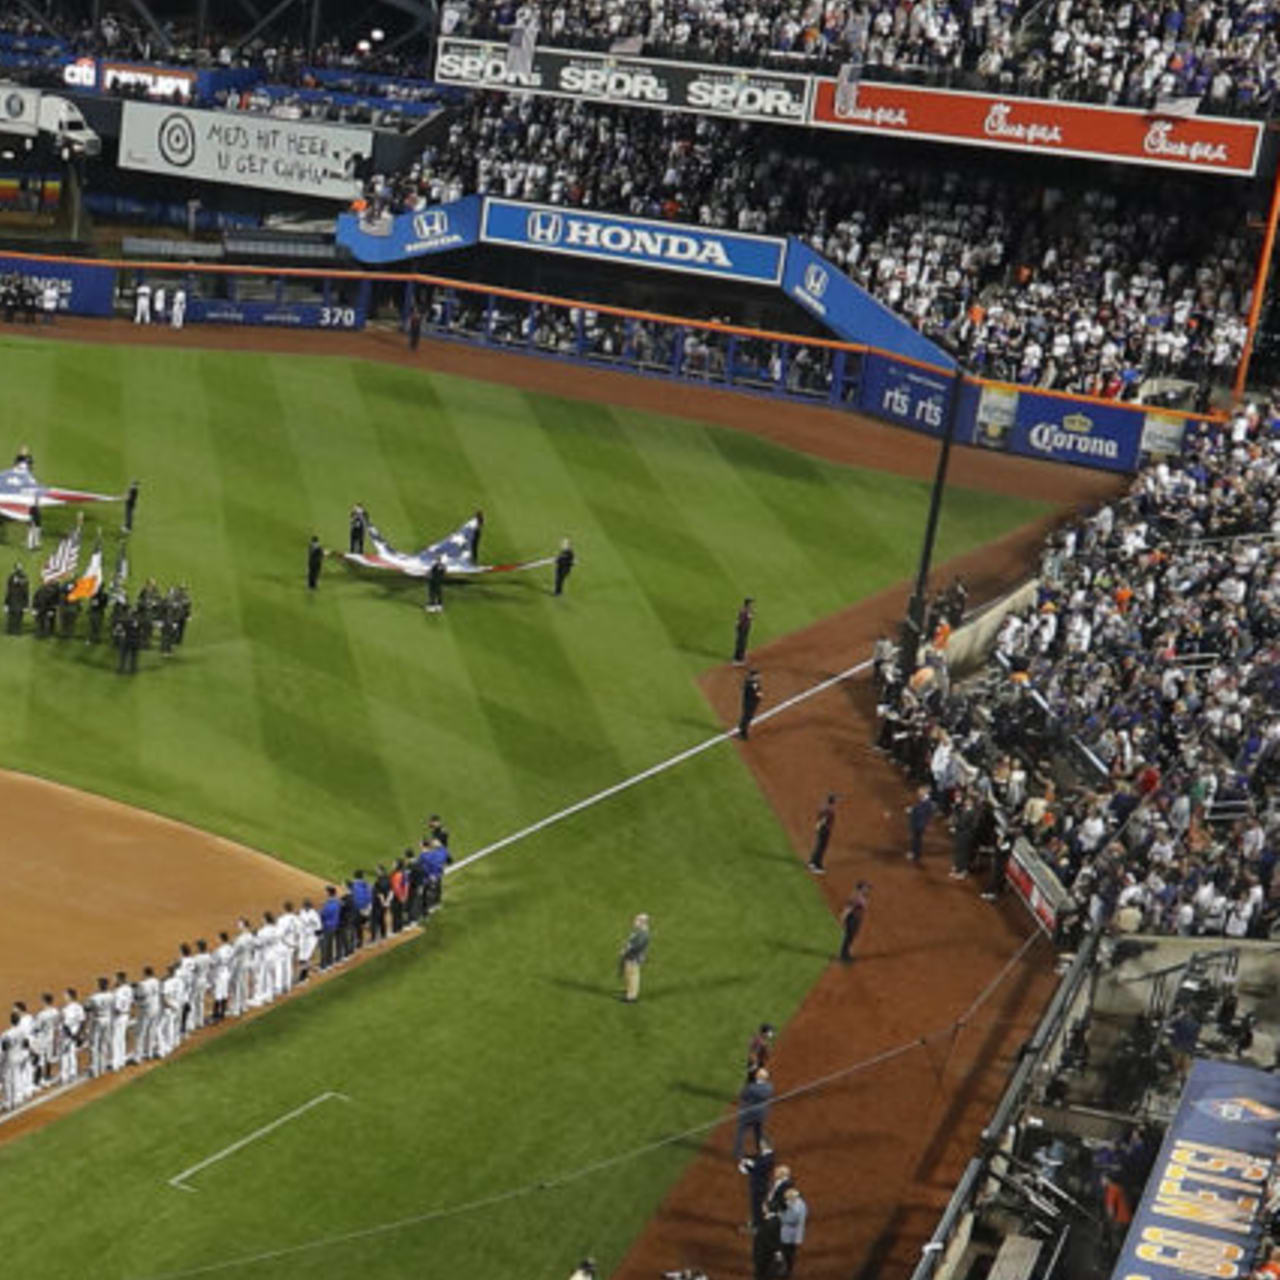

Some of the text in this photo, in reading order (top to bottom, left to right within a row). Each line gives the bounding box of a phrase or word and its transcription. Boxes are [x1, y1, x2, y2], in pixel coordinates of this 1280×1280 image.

[403, 234, 463, 252] HONDA
[565, 220, 733, 268] HONDA
[320, 306, 356, 327] 370
[1029, 422, 1119, 458] Corona
